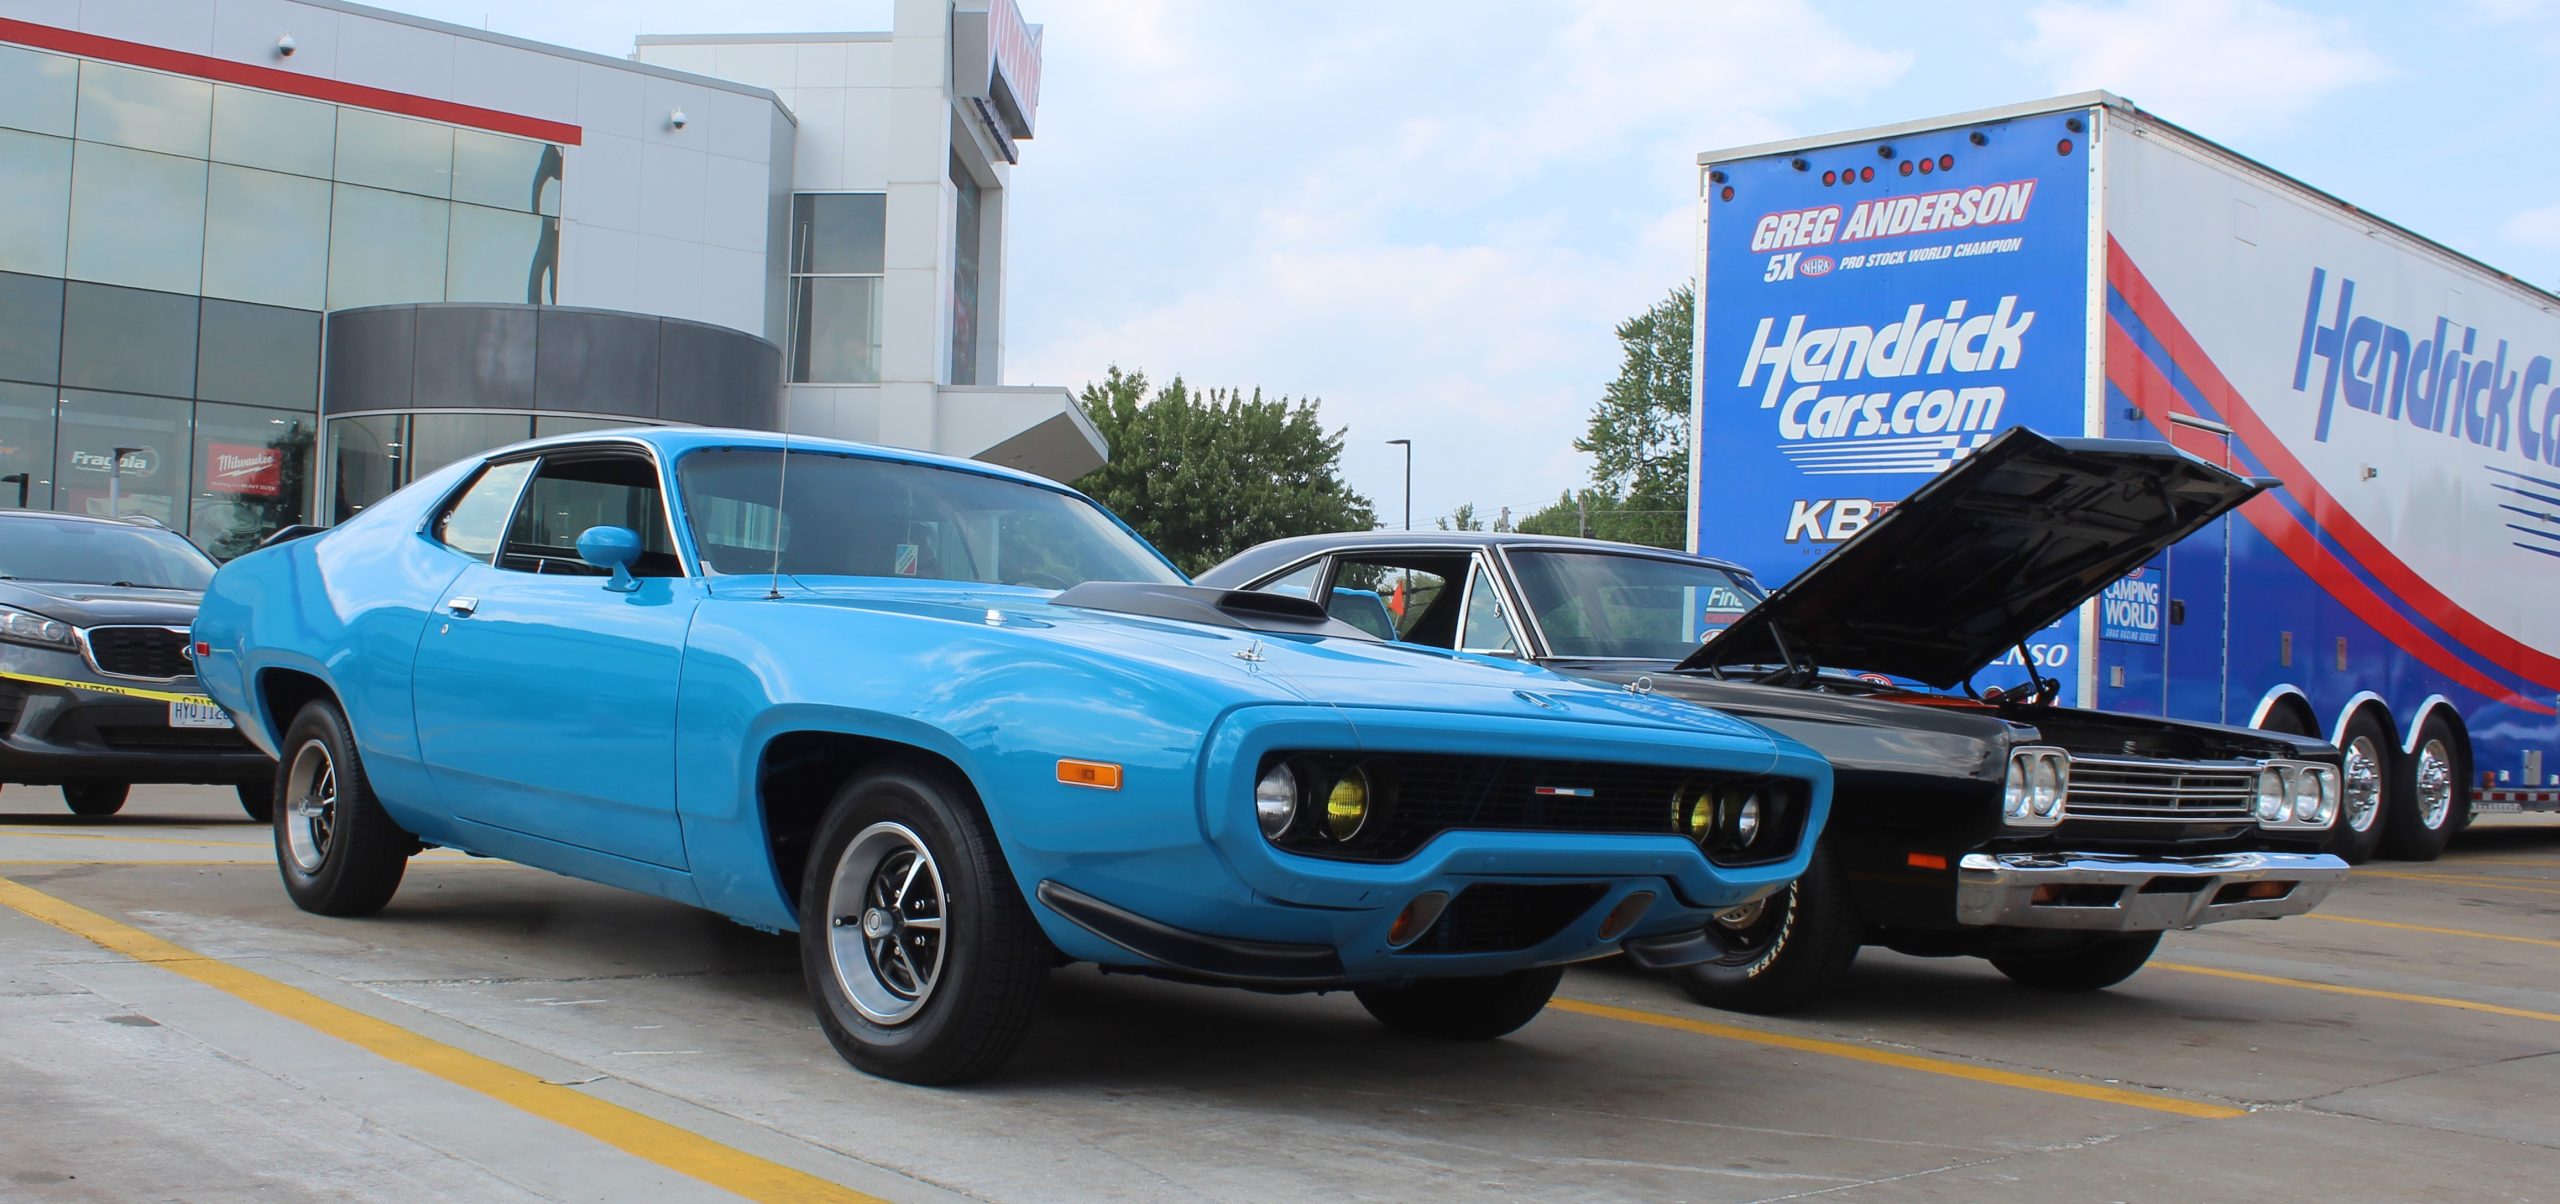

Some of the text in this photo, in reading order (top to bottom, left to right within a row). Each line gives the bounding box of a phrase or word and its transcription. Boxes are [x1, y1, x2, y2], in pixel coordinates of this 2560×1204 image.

[1750, 179, 2036, 253] GREG ANDERSON
[1764, 238, 2022, 282] 5X NHRA PRO STOCK WORLD CHAMPION
[1738, 296, 2035, 409] Hendrick
[1778, 385, 2006, 440] Cars.com
[217, 454, 274, 472] Milwaukee
[2105, 598, 2158, 630] WORLD
[1747, 880, 1798, 978] UALIFIER
